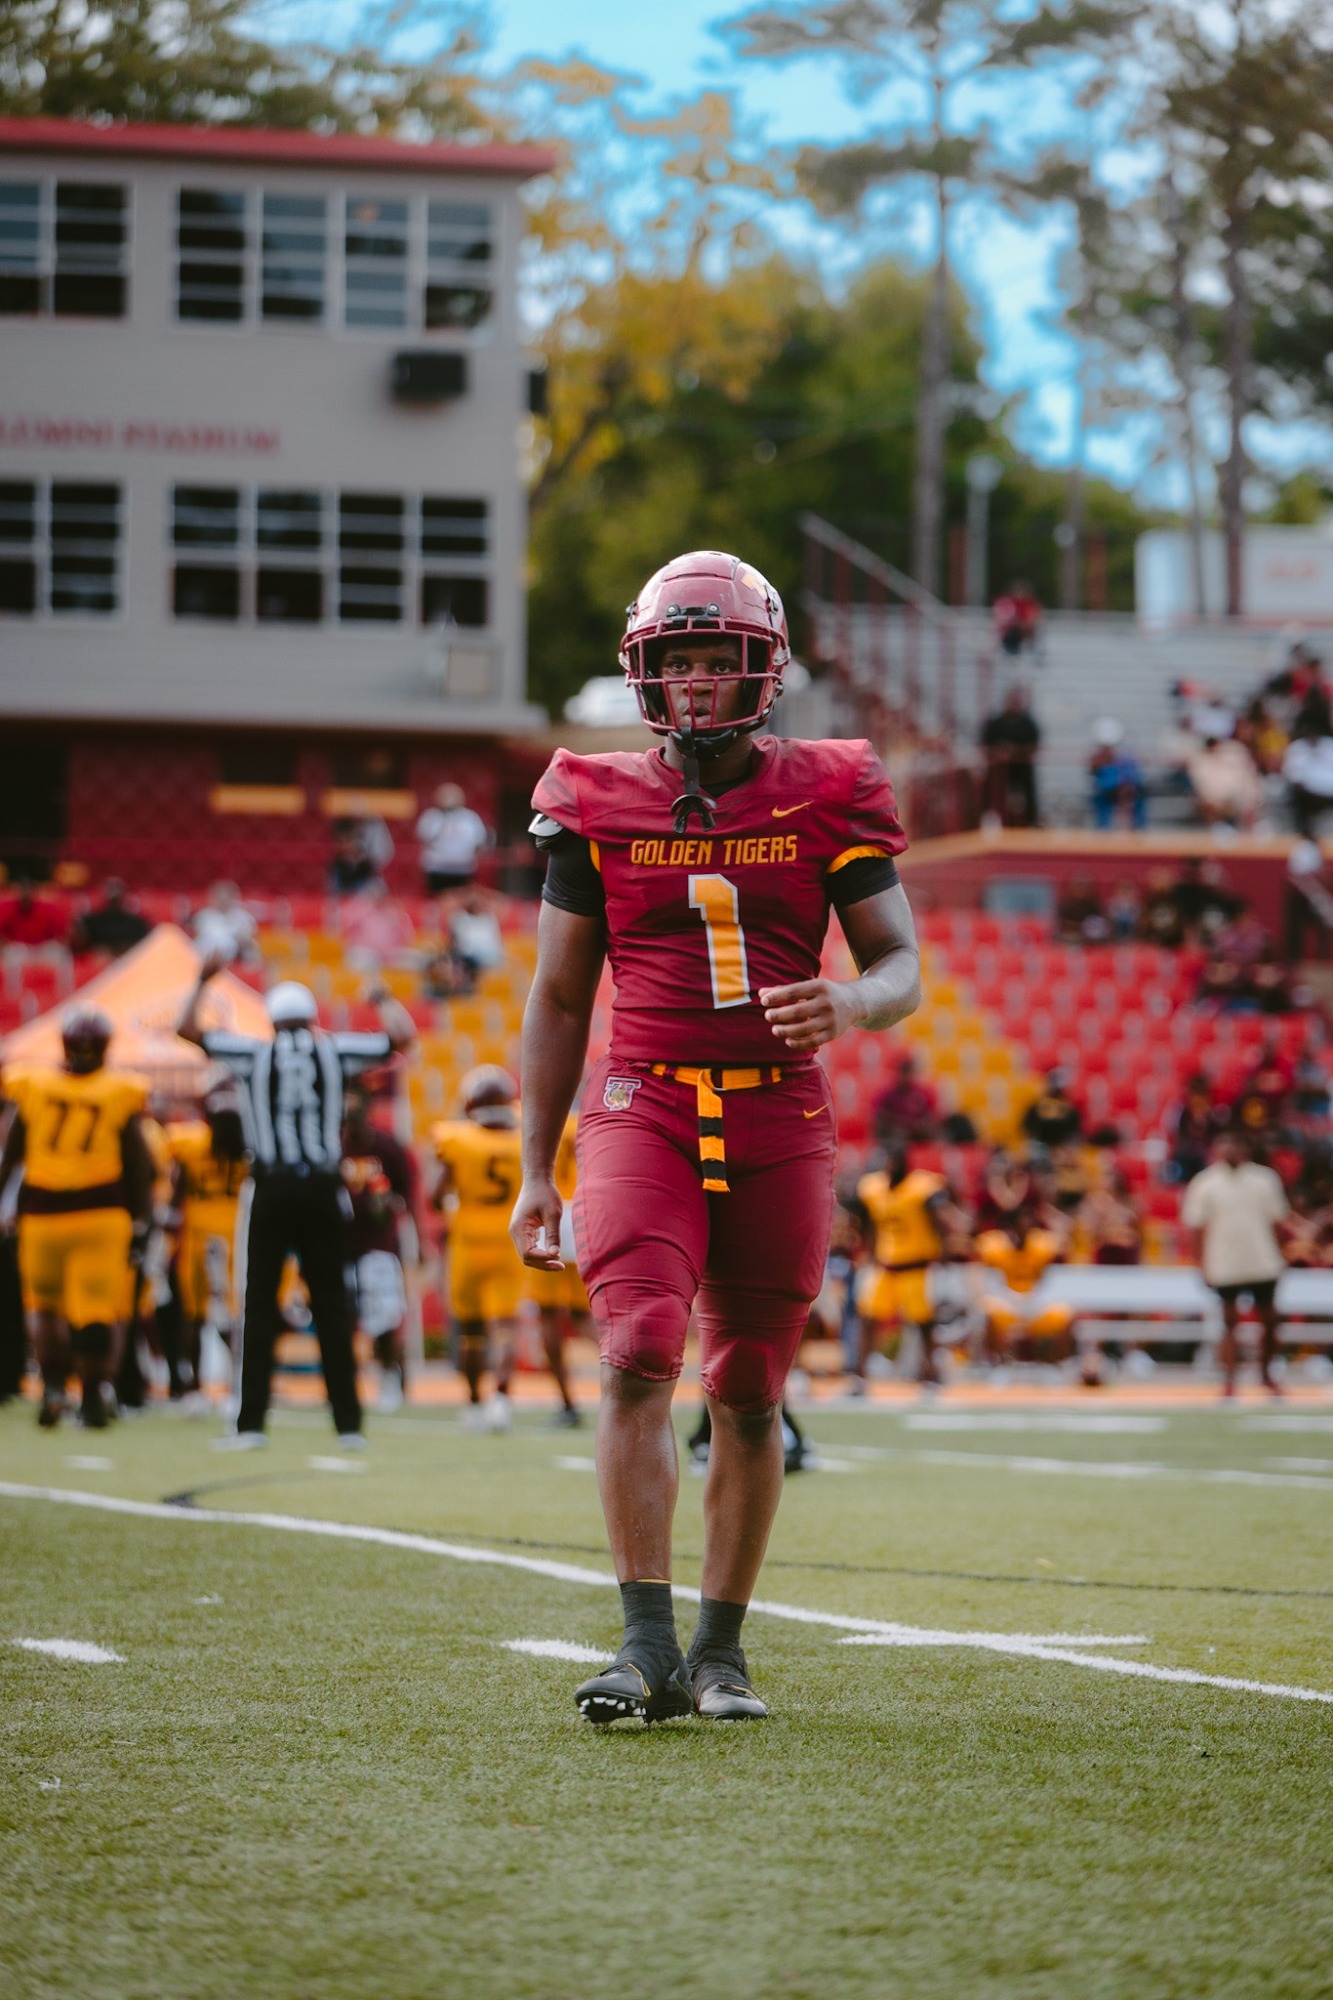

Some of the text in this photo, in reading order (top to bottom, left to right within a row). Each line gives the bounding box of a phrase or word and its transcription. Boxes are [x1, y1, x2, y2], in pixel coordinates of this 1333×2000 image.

[631, 835, 798, 866] GOLDEN TIGERS
[688, 873, 752, 1010] 1
[44, 1094, 103, 1155] 77
[484, 1154, 513, 1206] 5
